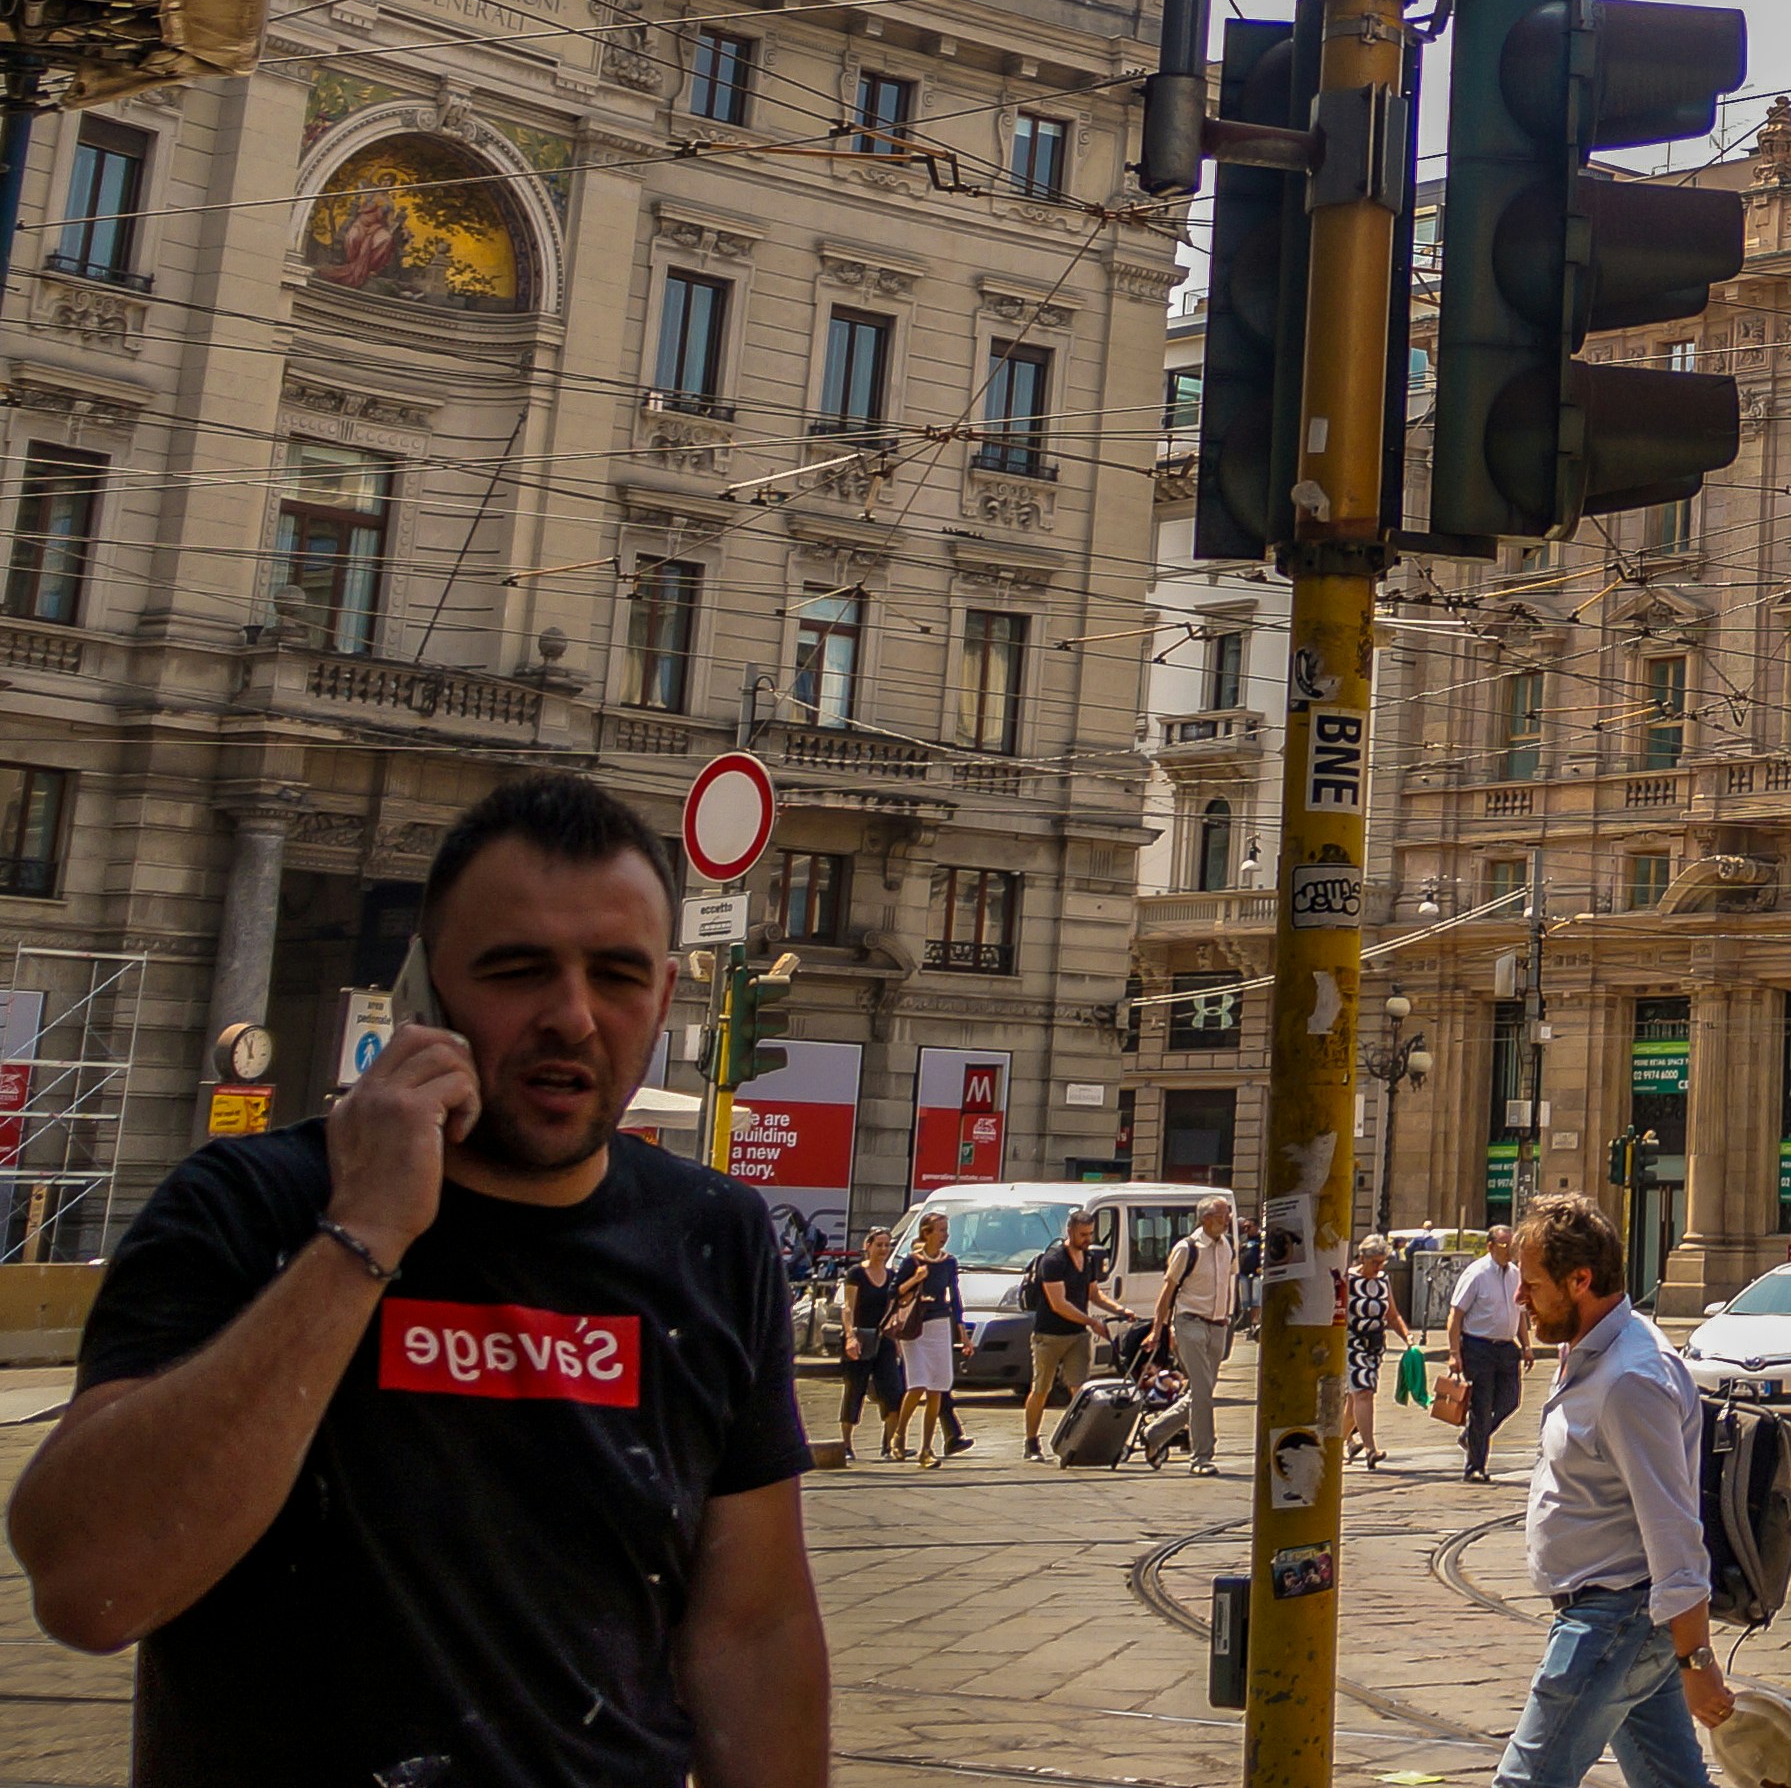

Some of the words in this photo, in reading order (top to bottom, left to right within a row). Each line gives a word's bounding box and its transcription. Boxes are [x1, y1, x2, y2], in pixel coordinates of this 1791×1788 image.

[1311, 714, 1363, 806] BNE
[701, 902, 733, 914] eccetto
[966, 1075, 993, 1103] M
[764, 1113, 790, 1126] are
[733, 1127, 798, 1148] building
[732, 1147, 742, 1159] a
[746, 1146, 782, 1160] new
[730, 1161, 775, 1180] story.
